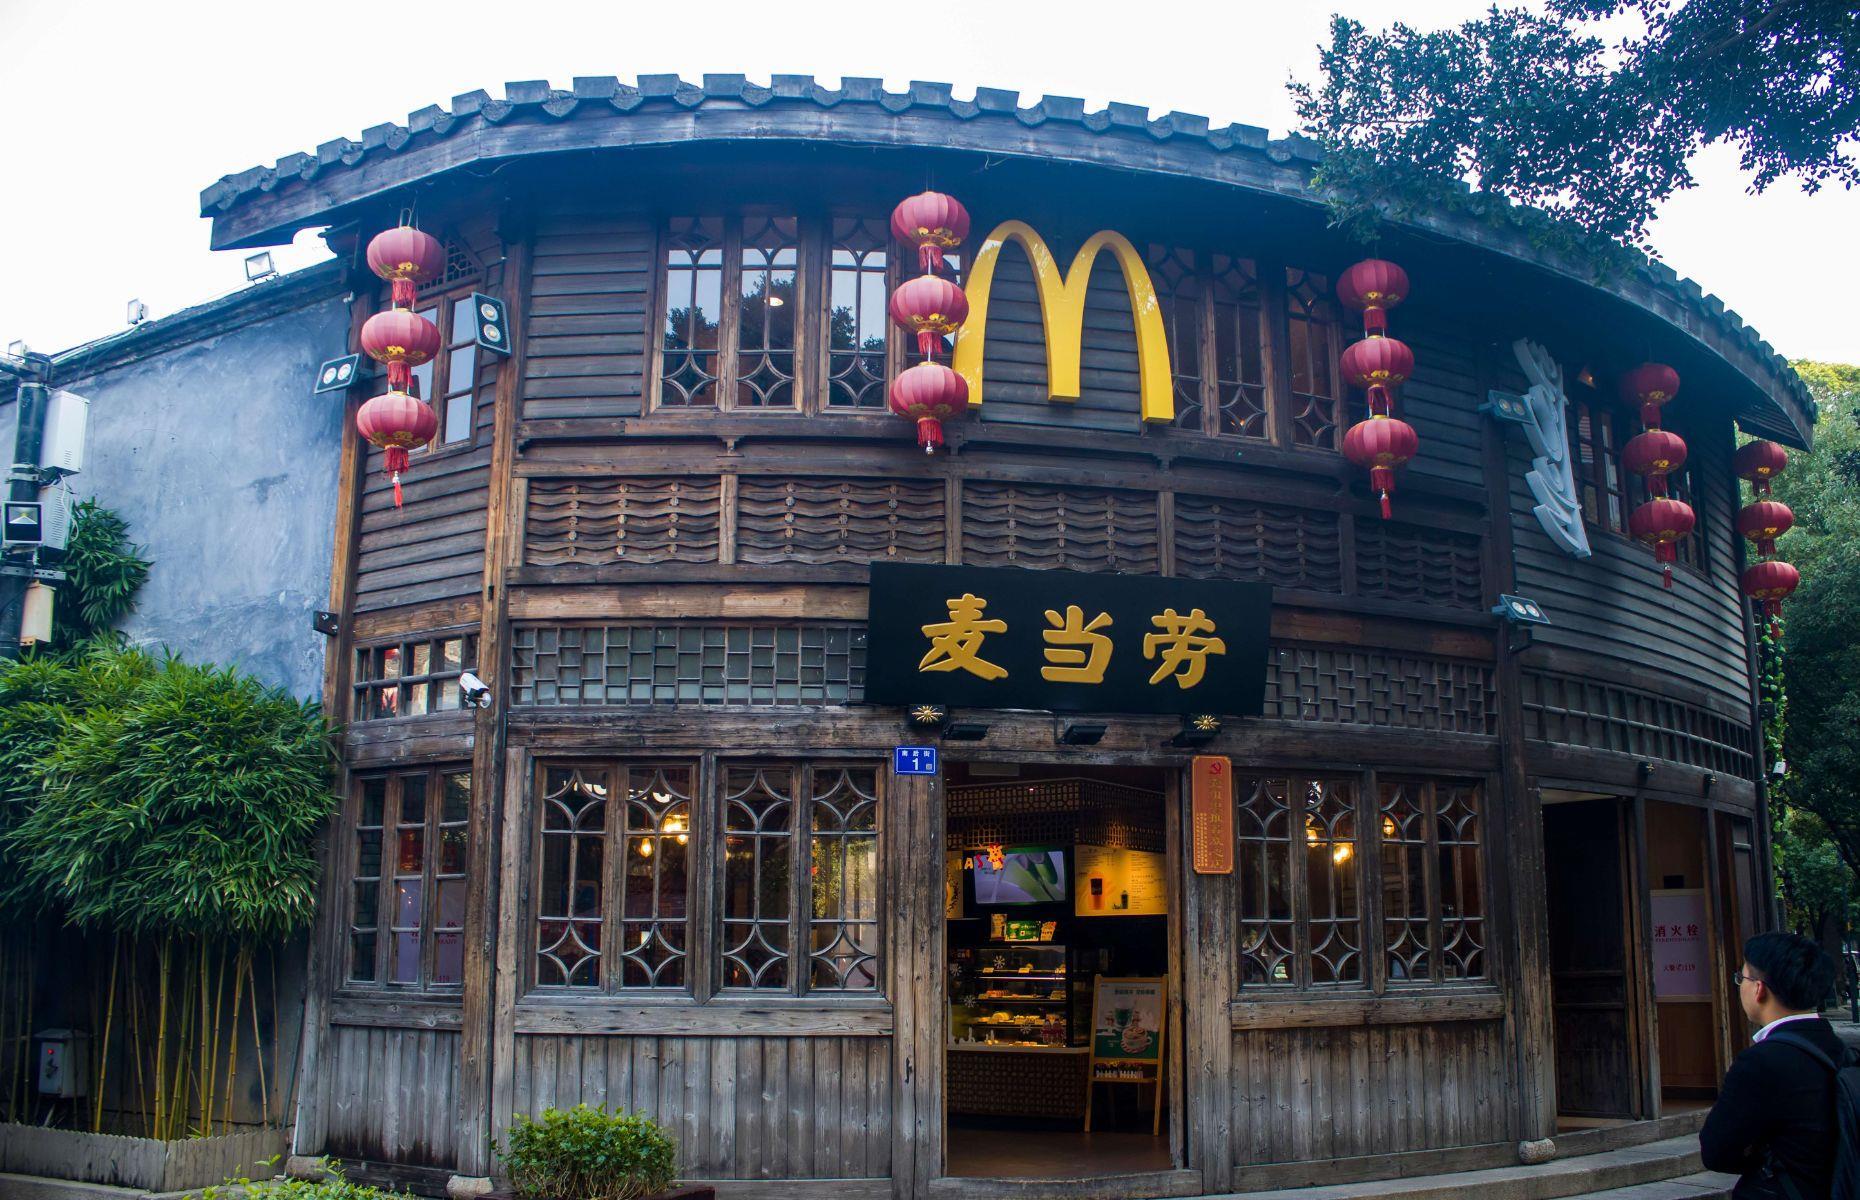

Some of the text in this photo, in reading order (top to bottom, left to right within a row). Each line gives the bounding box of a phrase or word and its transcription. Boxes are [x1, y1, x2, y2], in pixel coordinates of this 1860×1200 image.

[918, 592, 1226, 689] 麦当劳
[912, 757, 919, 770] 1
[1654, 924, 1699, 937] 消火栓
